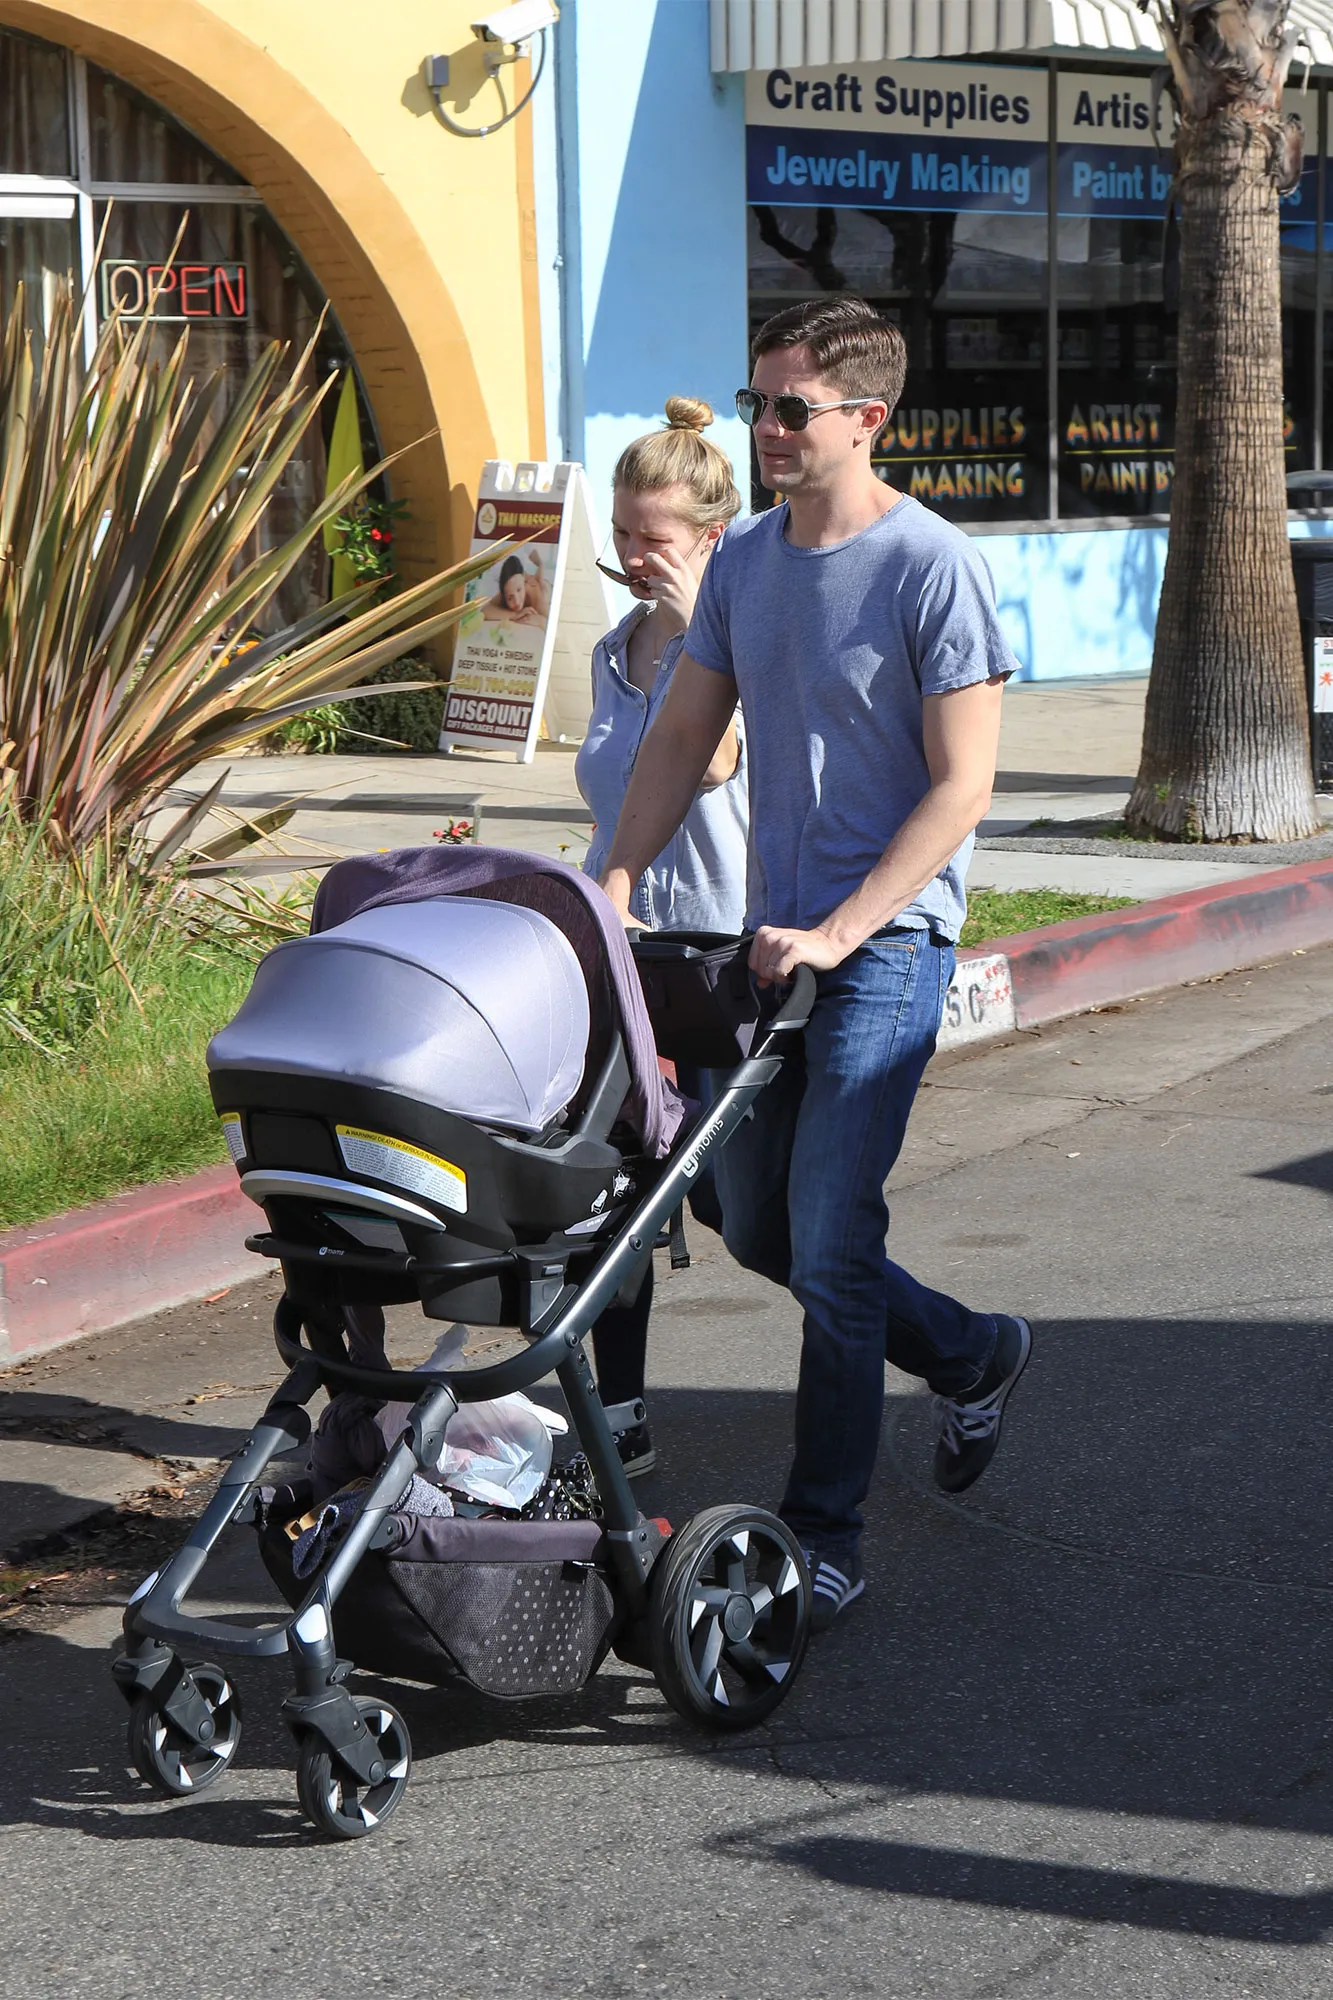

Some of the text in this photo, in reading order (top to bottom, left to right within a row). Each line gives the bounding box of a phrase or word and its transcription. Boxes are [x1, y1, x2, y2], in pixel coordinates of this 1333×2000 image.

[765, 69, 1030, 129] Craft Supplies
[766, 146, 1030, 204] Jewelry Making
[1072, 161, 1144, 200] Paint
[109, 265, 245, 316] OPEN
[1067, 404, 1162, 444] ARTIST
[909, 462, 1025, 499] MAKING
[1080, 461, 1149, 494] PAINT
[498, 512, 518, 526] THAI
[458, 659, 475, 669] DEEP
[475, 661, 498, 672] TISSUE
[503, 664, 516, 674] HOT
[482, 647, 498, 658] YOGA
[504, 650, 534, 660] SWEDISH
[448, 698, 531, 727] DISCOUNT
